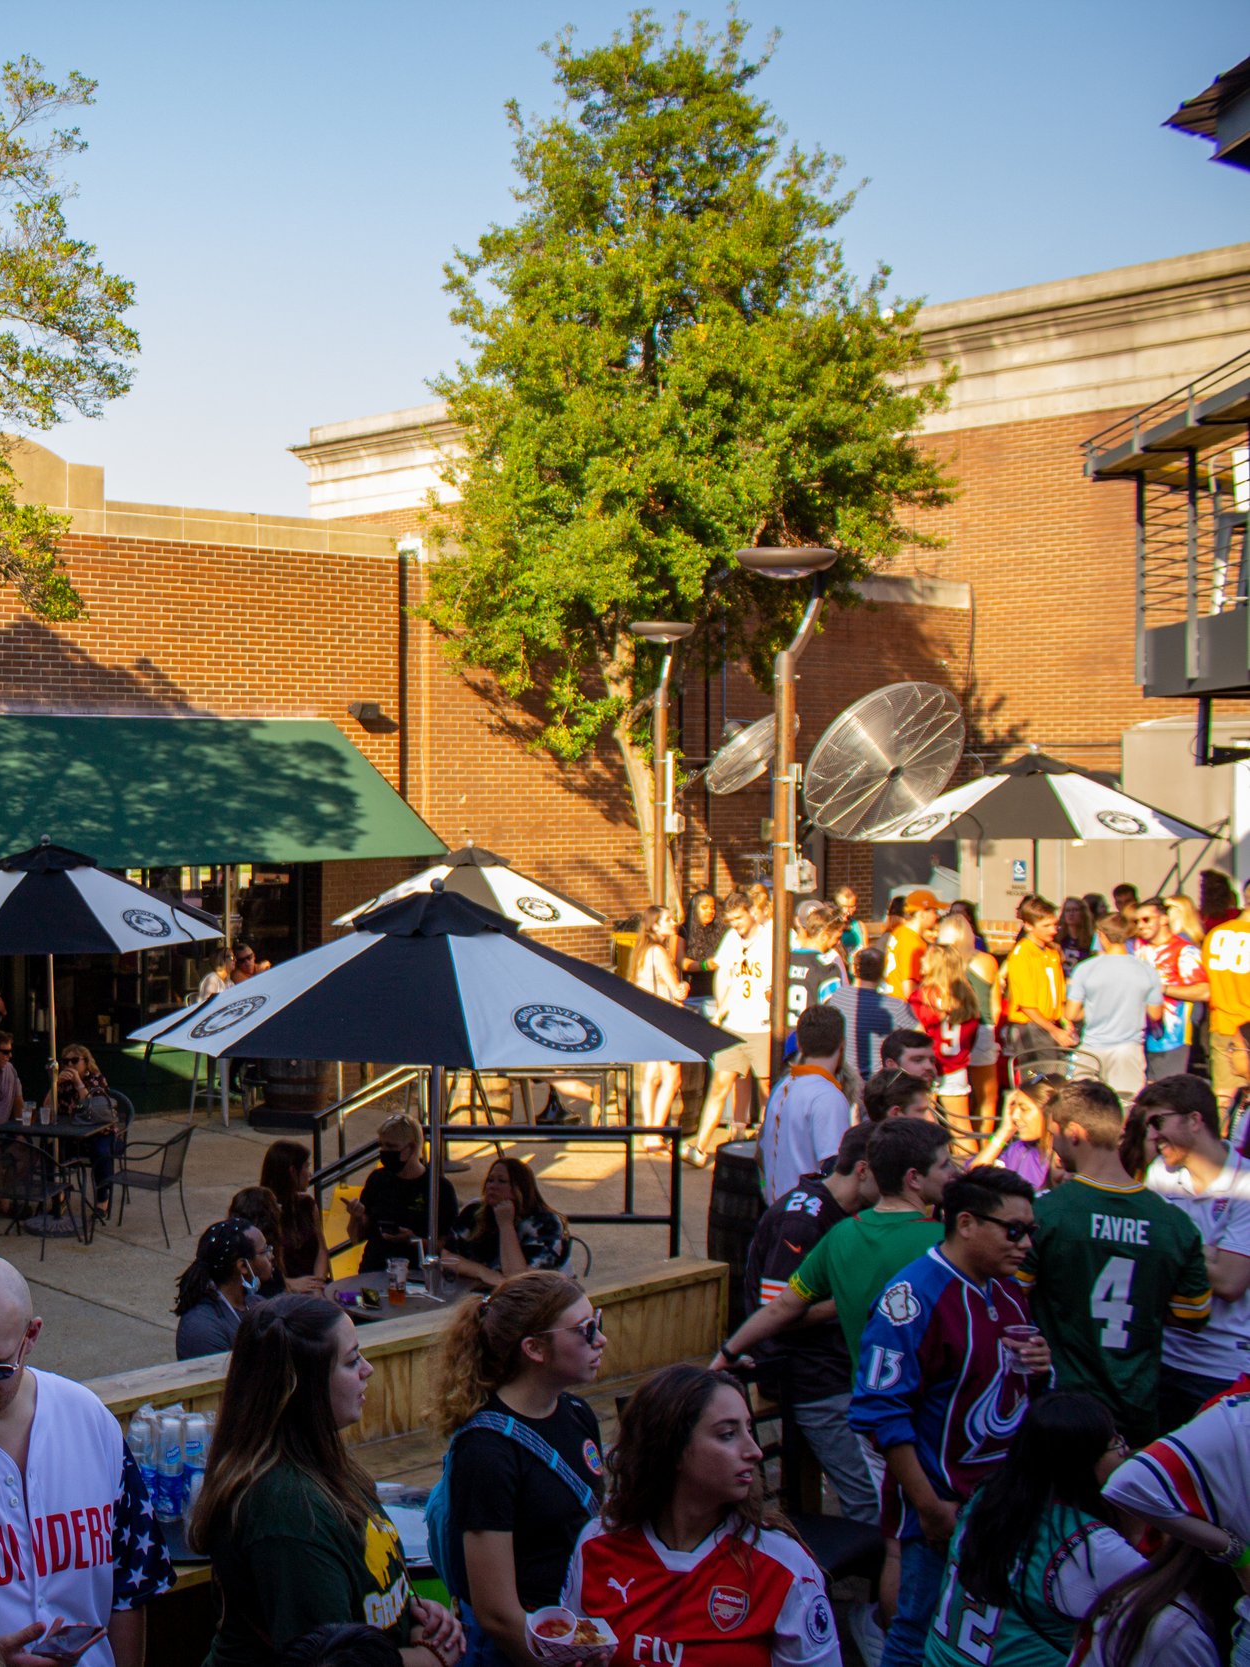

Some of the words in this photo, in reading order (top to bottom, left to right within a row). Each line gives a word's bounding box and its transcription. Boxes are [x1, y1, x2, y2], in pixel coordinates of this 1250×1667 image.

[1209, 929, 1250, 974] 98
[742, 979, 751, 999] 3
[517, 1005, 543, 1022] GHOST
[544, 1006, 581, 1021] RIVER
[784, 1190, 823, 1217] 24
[1090, 1212, 1150, 1246] FAVRE
[1089, 1255, 1136, 1349] 4
[866, 1344, 905, 1391] 13
[713, 1591, 743, 1604] Arsenal
[632, 1633, 685, 1667] Fly
